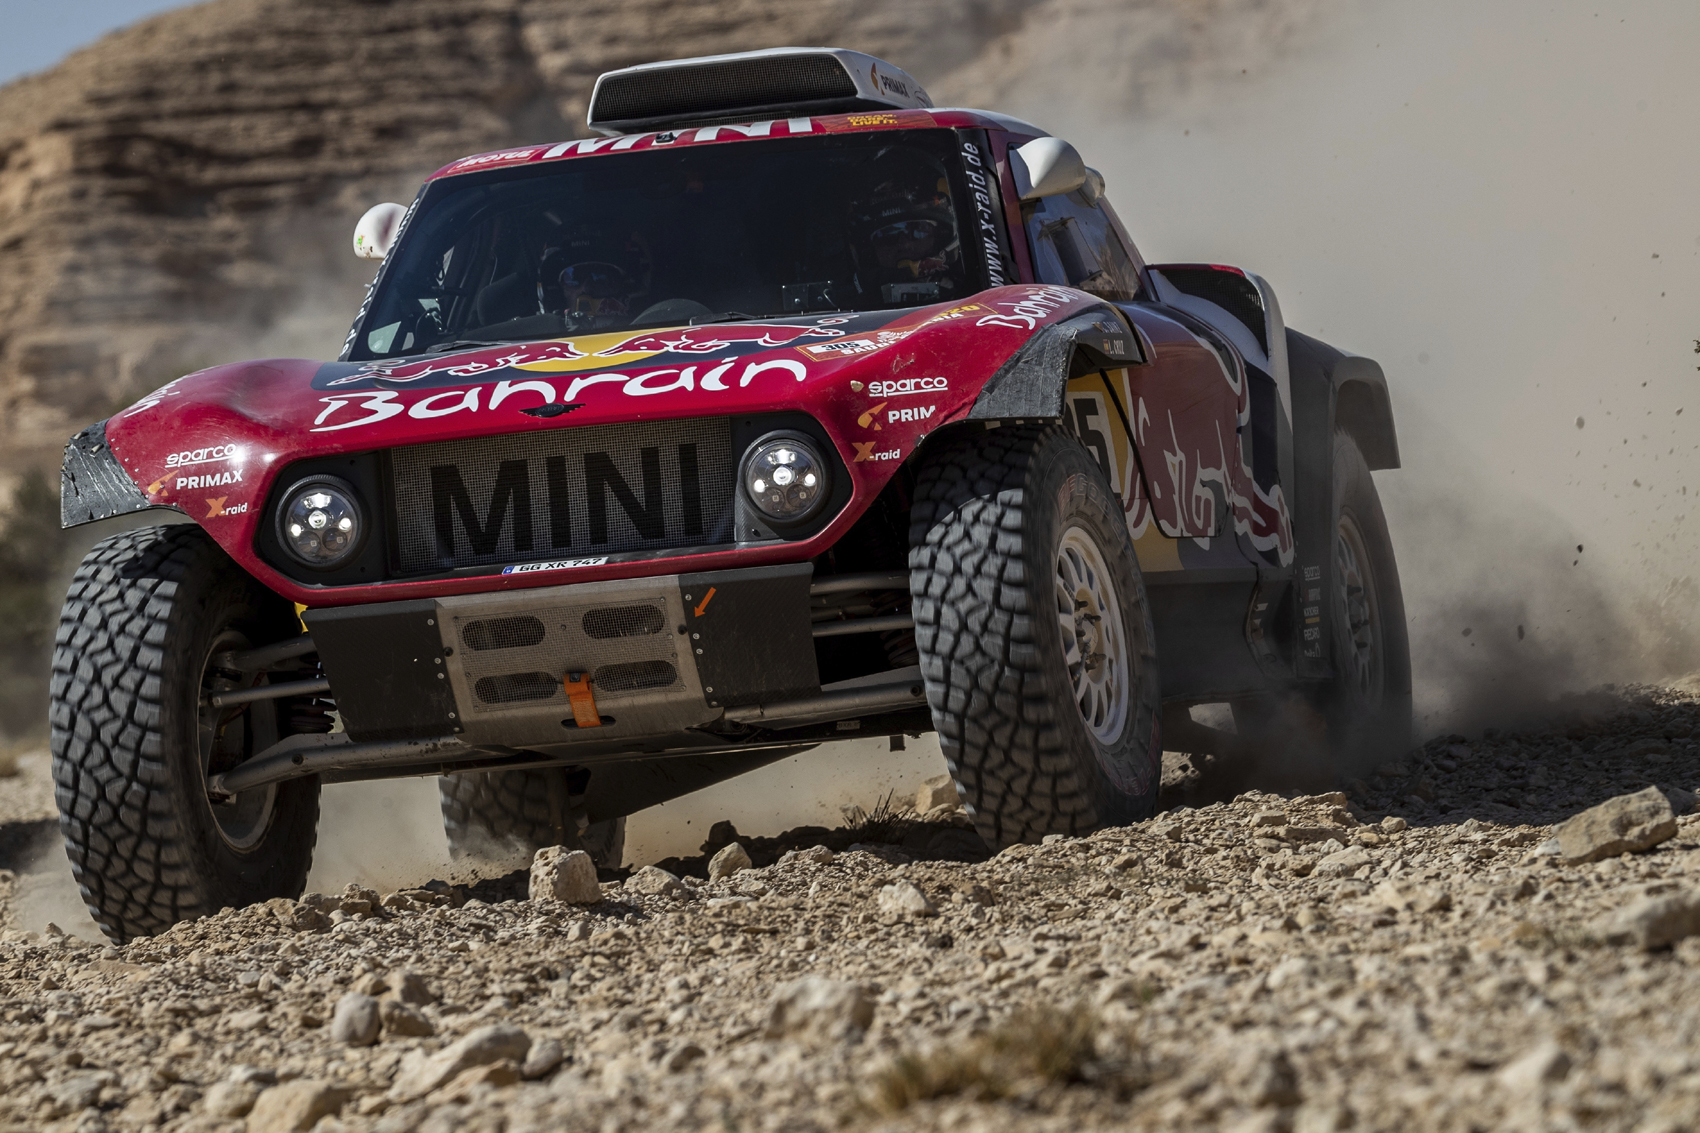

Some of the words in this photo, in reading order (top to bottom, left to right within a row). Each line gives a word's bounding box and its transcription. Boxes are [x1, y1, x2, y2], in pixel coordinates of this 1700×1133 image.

[821, 341, 860, 351] 305
[309, 357, 807, 433] Bahrain
[868, 376, 948, 397] sparco
[165, 443, 238, 468] sparco
[851, 441, 900, 463] X-raid
[175, 468, 243, 490] PRIMAX
[205, 495, 248, 519] X-raid
[430, 443, 702, 558] MINI
[519, 563, 541, 572] GG
[545, 561, 567, 570] XR
[572, 558, 603, 567] 747
